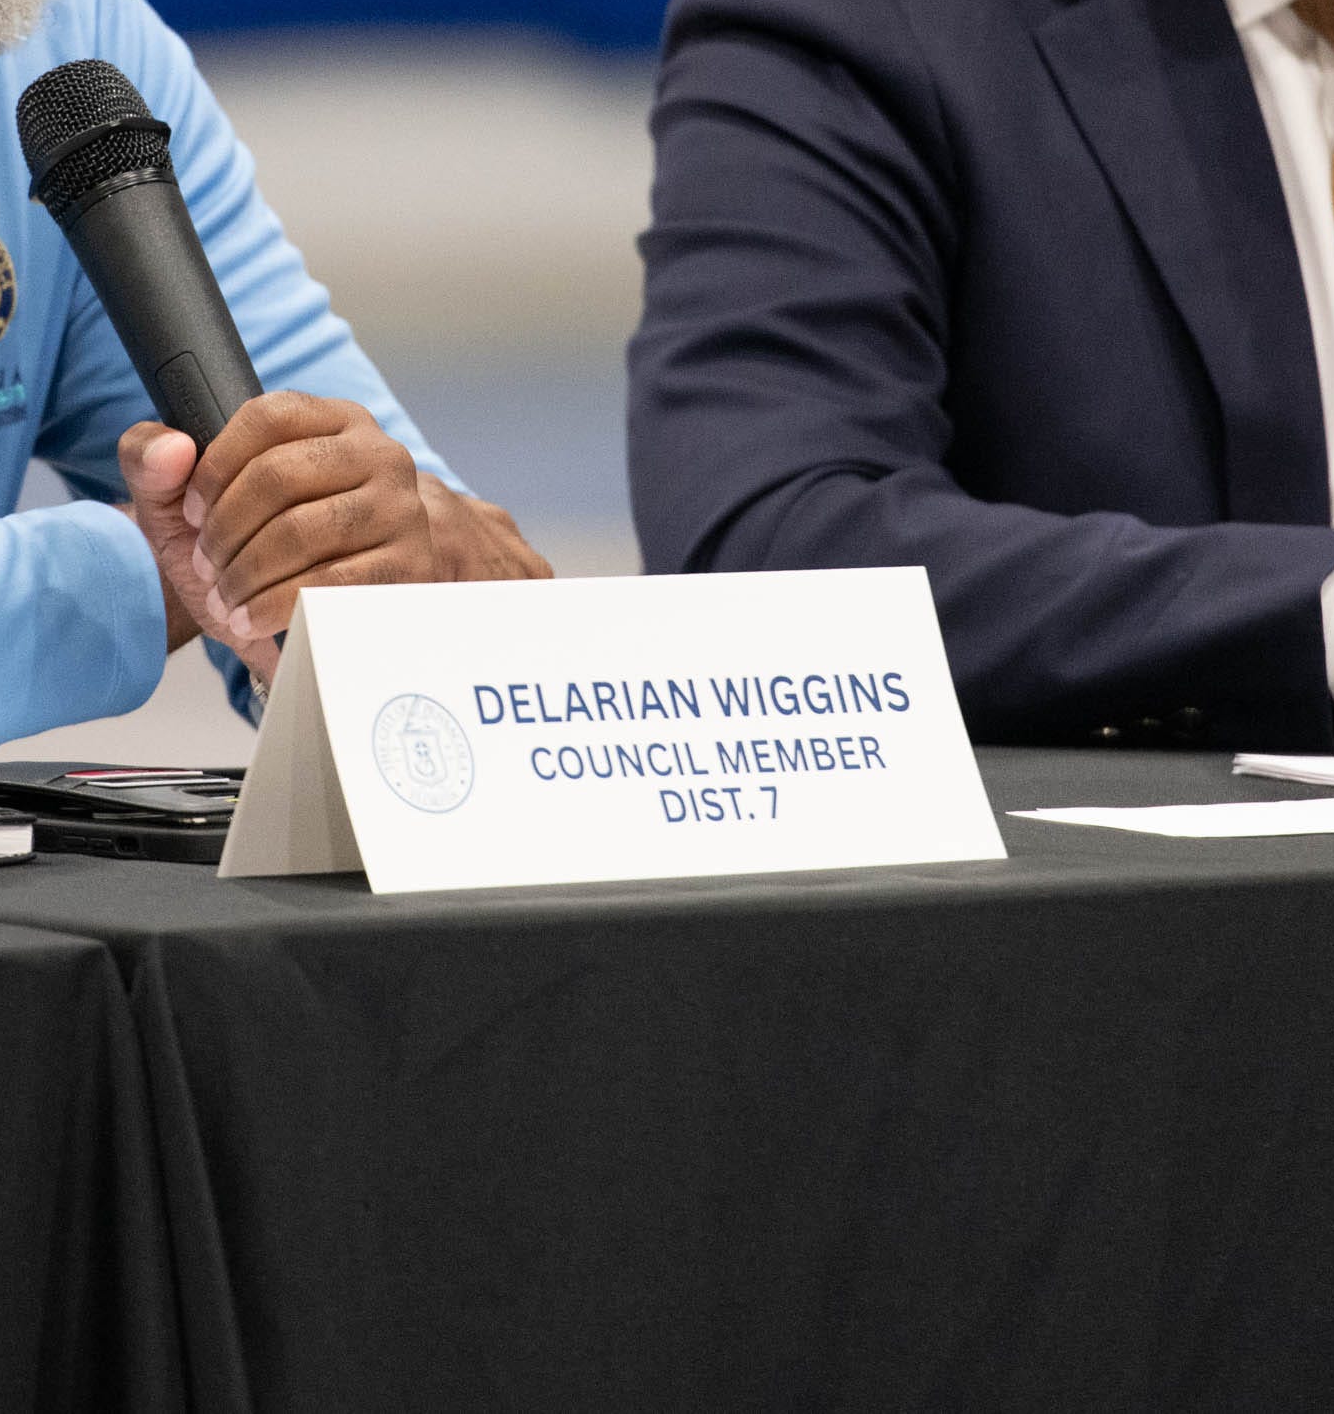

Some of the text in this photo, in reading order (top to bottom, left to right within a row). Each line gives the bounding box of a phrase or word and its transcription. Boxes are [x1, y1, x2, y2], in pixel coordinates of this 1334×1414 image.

[474, 673, 910, 724] DELARIAN WIGGINS
[531, 737, 886, 780] COUNCIL MEMBER
[659, 786, 777, 822] DIST. 7
